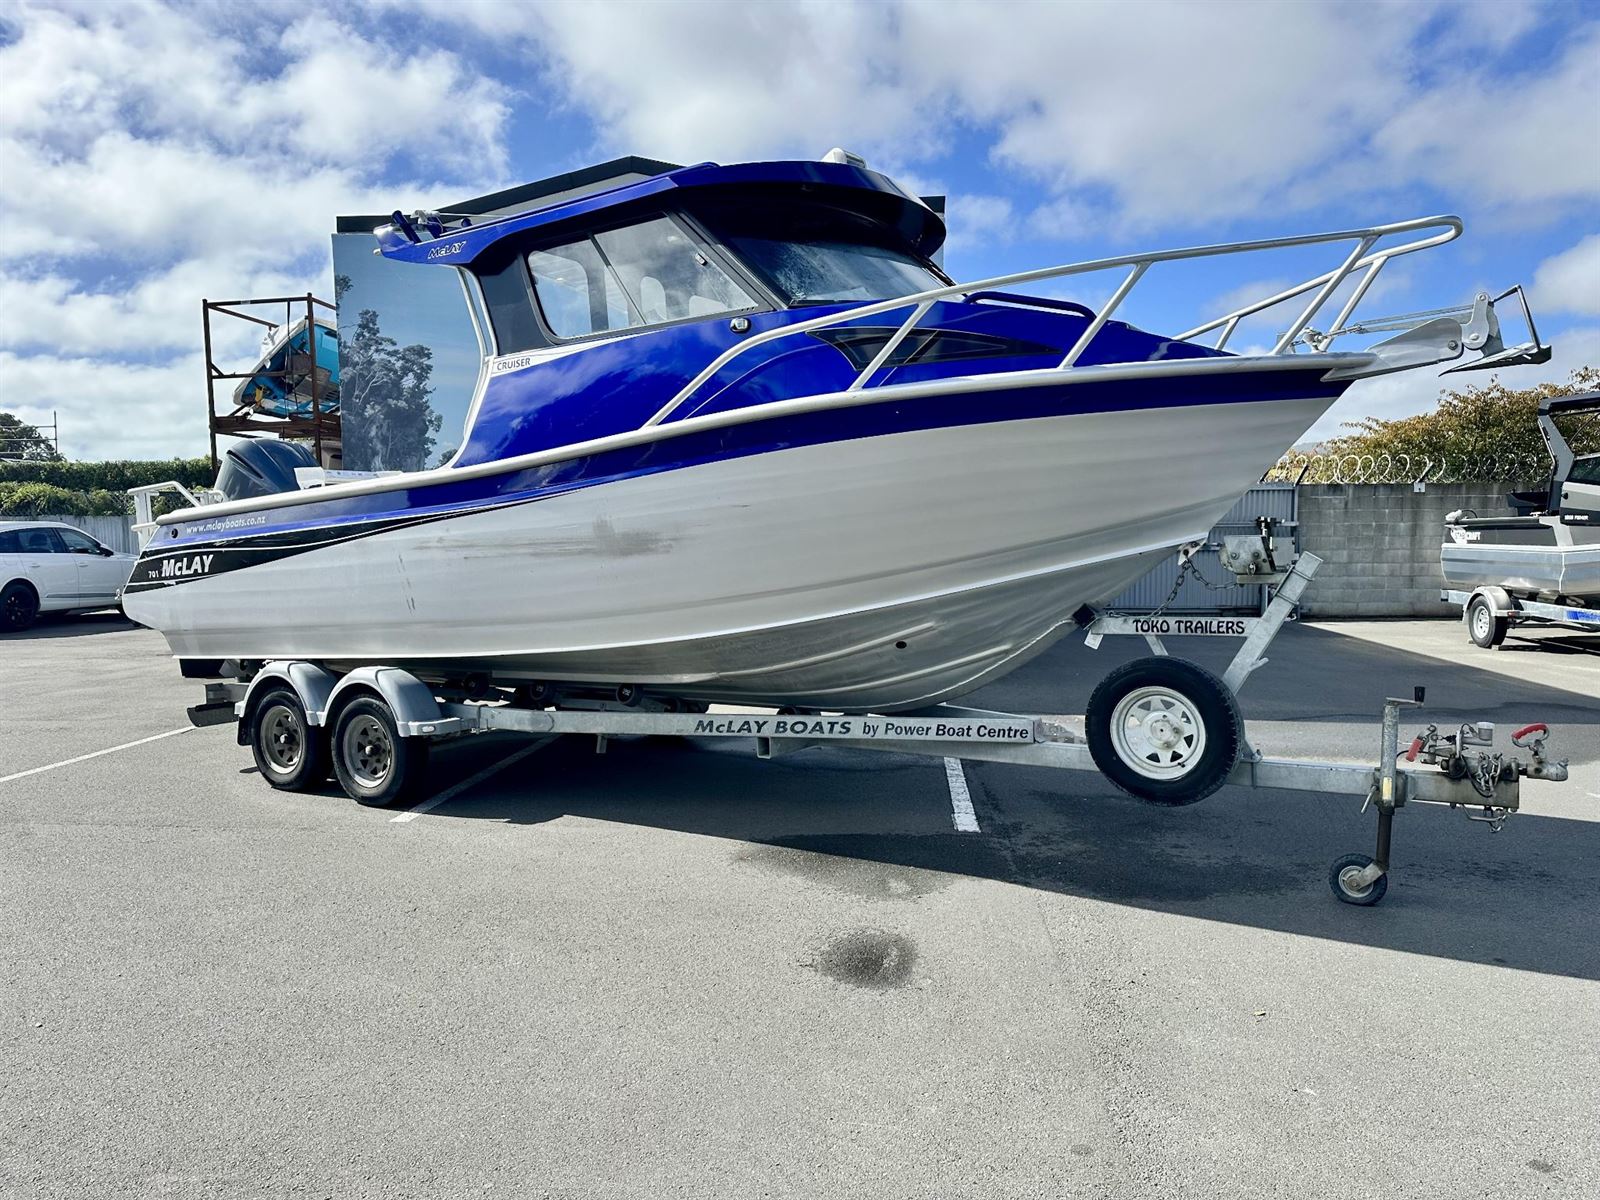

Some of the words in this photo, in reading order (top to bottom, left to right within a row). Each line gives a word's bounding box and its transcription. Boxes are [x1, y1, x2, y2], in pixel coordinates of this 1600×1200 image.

[428, 241, 467, 259] McLAY
[497, 357, 531, 371] CRUISER
[186, 516, 266, 533] www.mclayboats.co.nz
[148, 570, 159, 578] 701
[161, 554, 214, 577] McLAY
[1132, 619, 1170, 634] TOKO
[1174, 620, 1245, 635] TRAILERS
[694, 720, 769, 735] McLAY
[775, 720, 851, 735] BOATS
[862, 722, 879, 737] by
[884, 722, 932, 737] Power
[935, 724, 973, 738] Boat
[977, 725, 1029, 739] Centre
